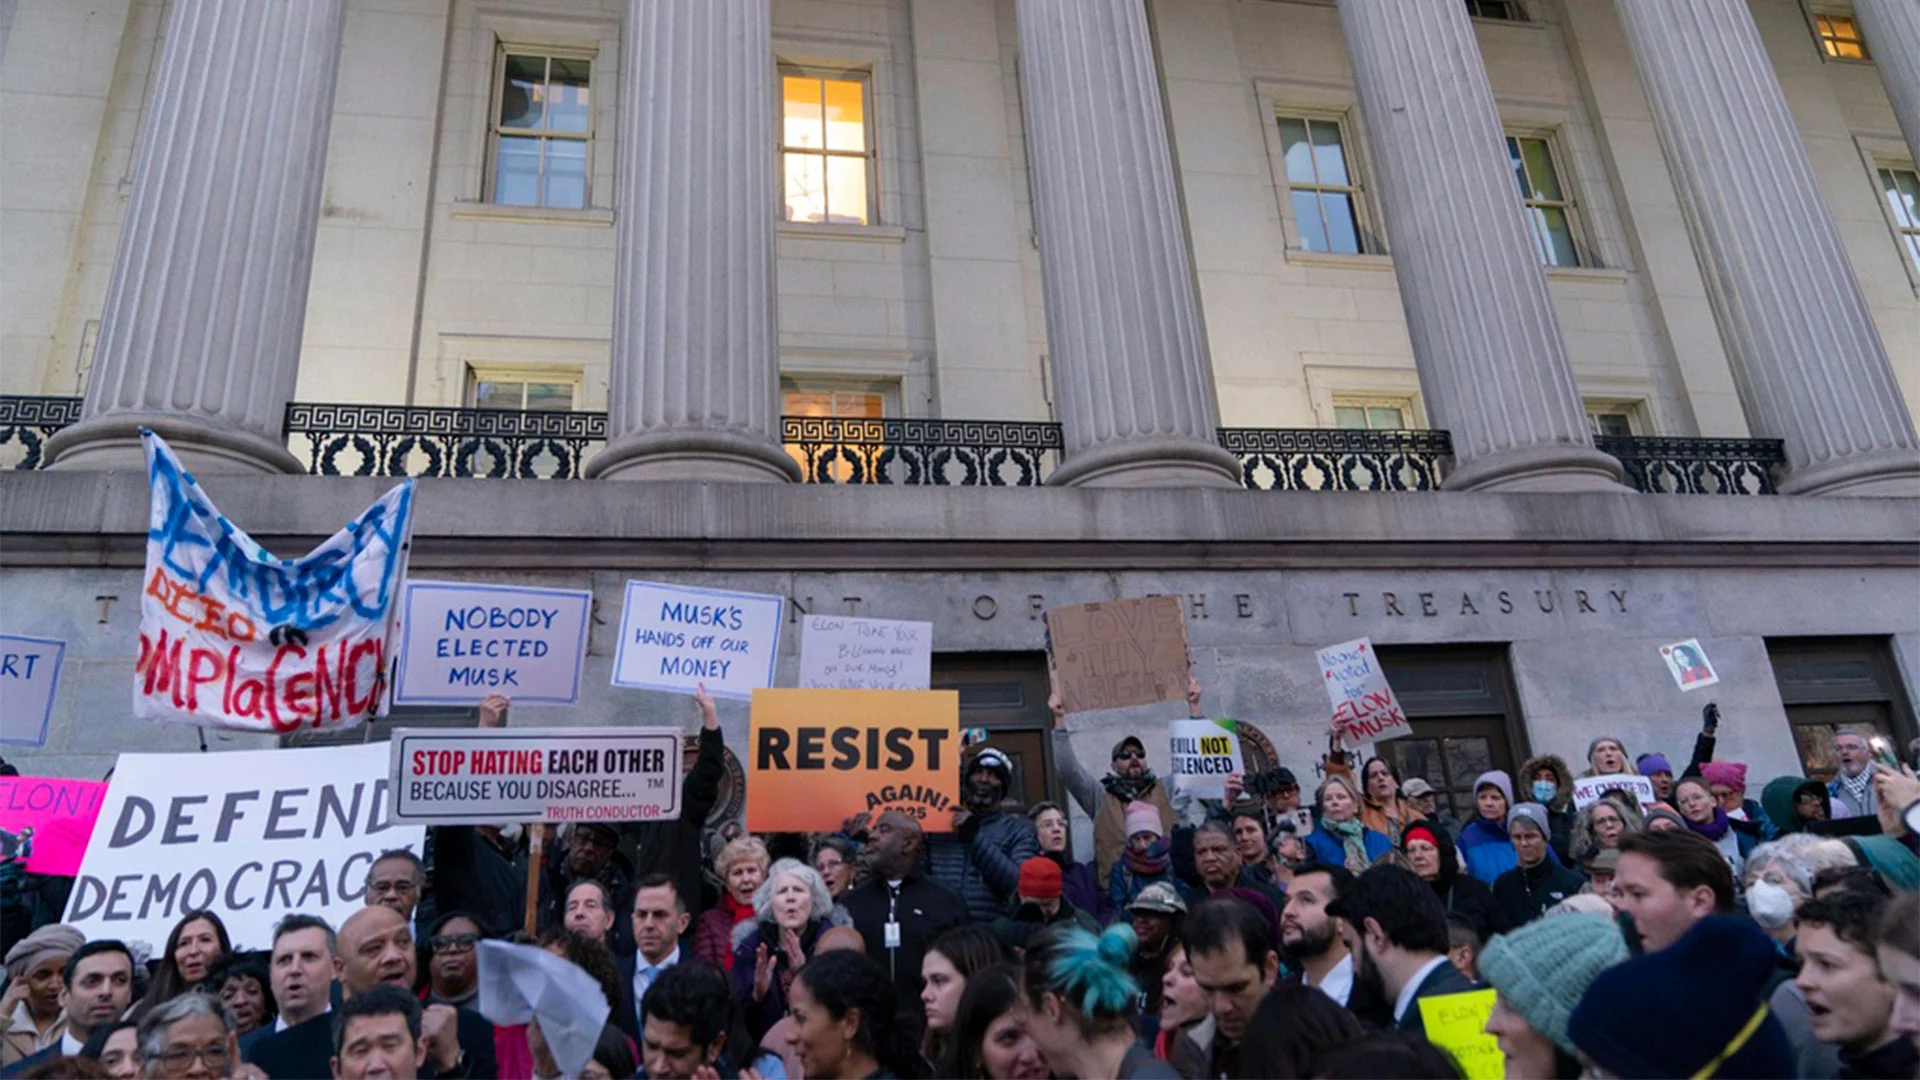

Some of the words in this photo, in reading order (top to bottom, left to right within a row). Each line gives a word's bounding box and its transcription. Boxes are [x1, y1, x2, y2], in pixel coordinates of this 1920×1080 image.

[660, 600, 744, 631] MUSK'S
[1343, 590, 1631, 617] TREASURY
[445, 606, 559, 632] NOBODY
[811, 618, 845, 631] ELON
[1052, 600, 1183, 648] LOVE
[436, 638, 549, 659] ELECTED
[635, 628, 686, 648] HANDS
[691, 635, 715, 650] OFF
[720, 638, 749, 655] OUR
[448, 666, 519, 687] MUSK
[660, 656, 732, 681] MONEY
[1348, 707, 1407, 741] MUSK
[757, 727, 949, 771] RESIST
[1201, 737, 1228, 754] NOT
[412, 749, 465, 776] STOP
[470, 749, 543, 775] HATING
[547, 748, 599, 774] EACH
[603, 748, 665, 773] OTHER
[410, 780, 492, 801] BECAUSE
[497, 780, 533, 800] YOU
[537, 779, 636, 799] DISAGREE...
[865, 784, 950, 812] AGAIN!
[546, 805, 584, 819] TRUTH
[586, 804, 660, 819] CONDUCTOR
[68, 843, 414, 922] DEMOCRAC
